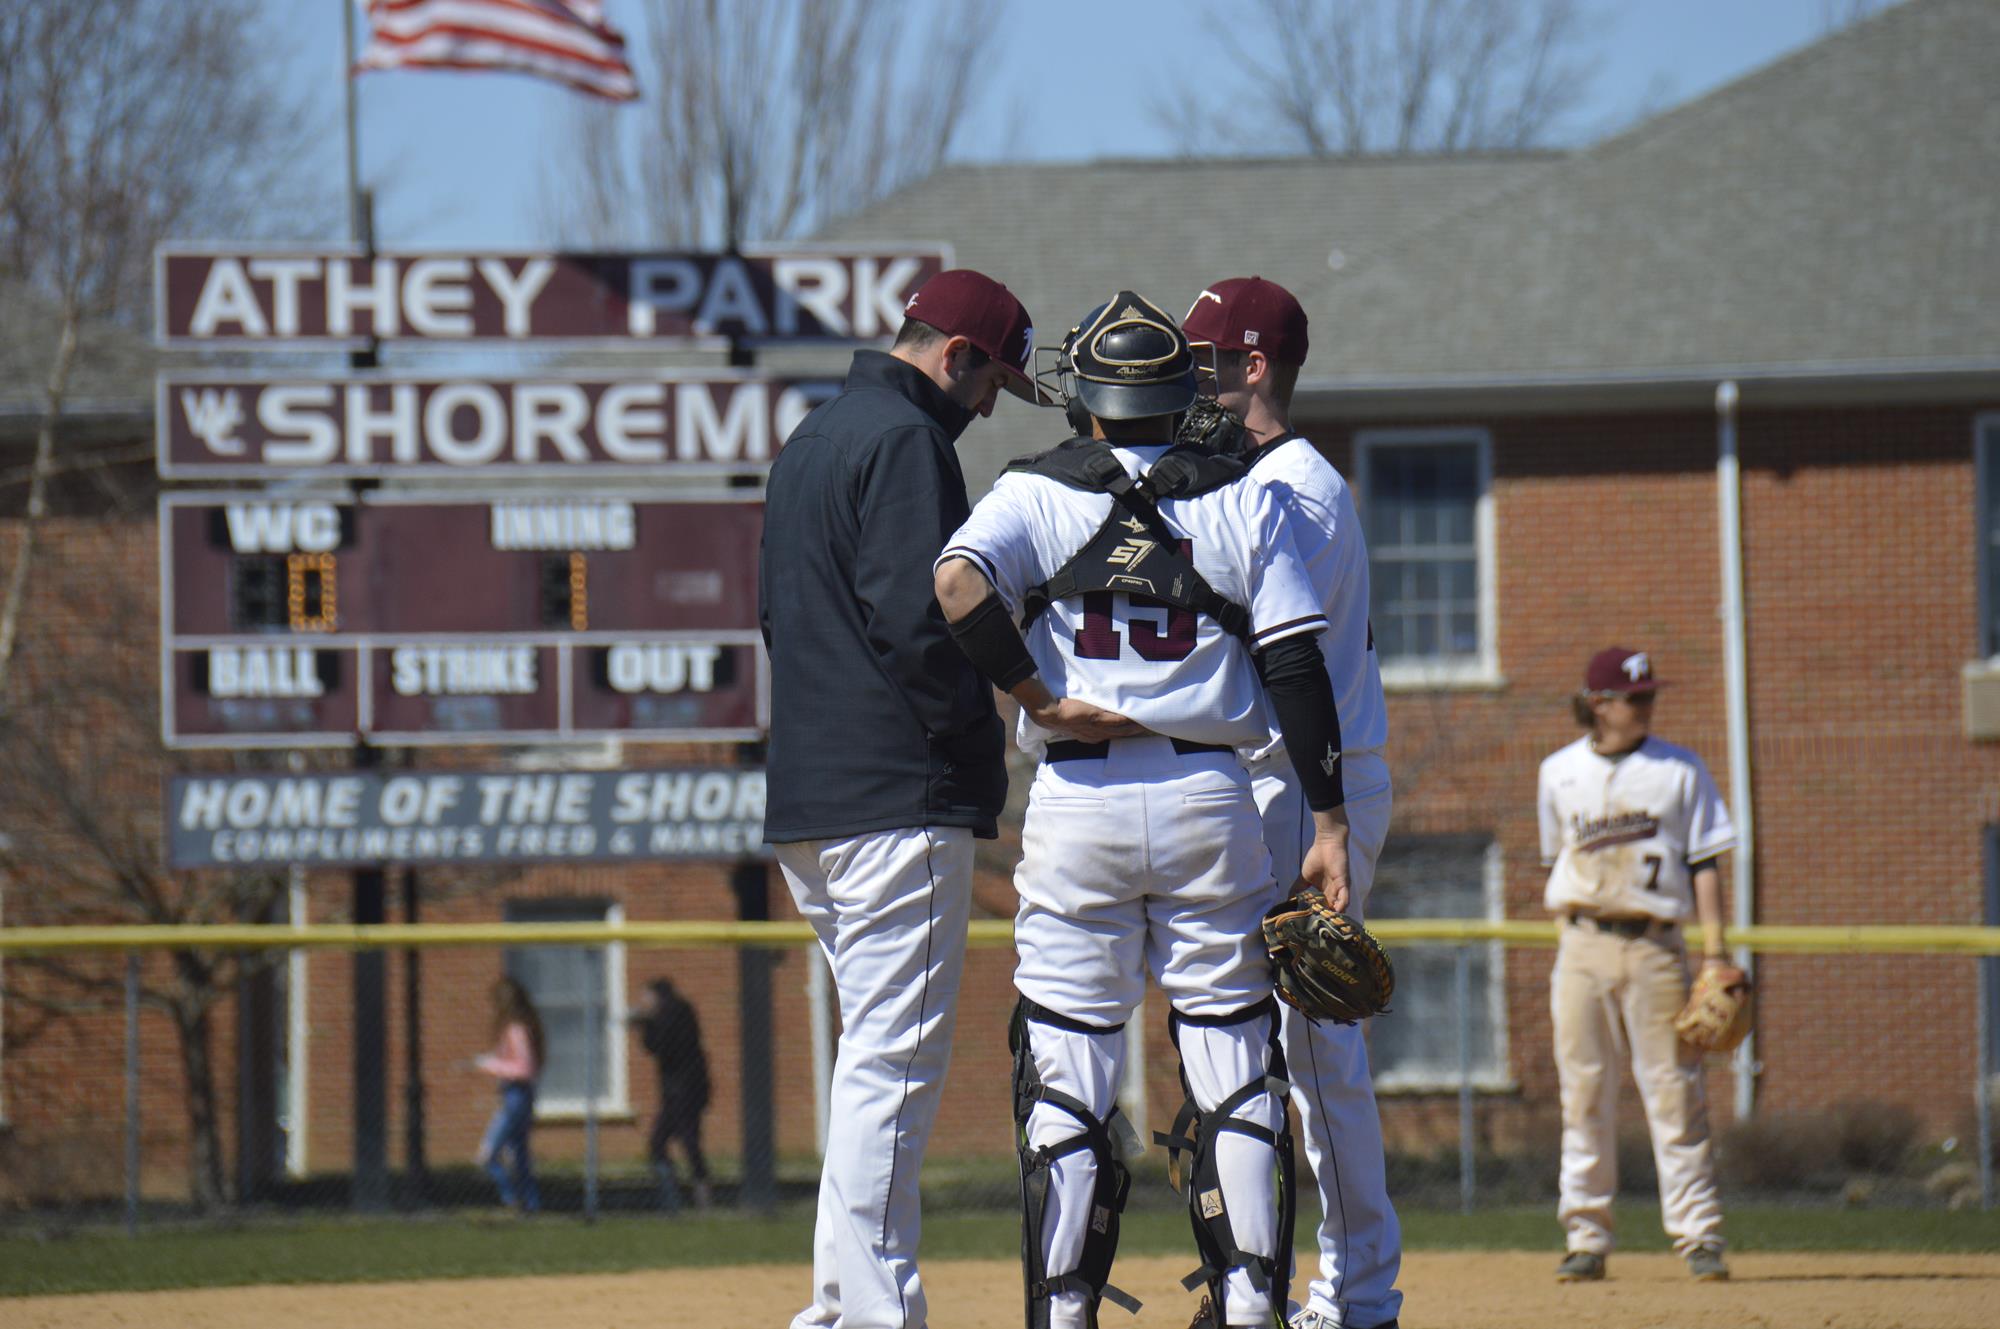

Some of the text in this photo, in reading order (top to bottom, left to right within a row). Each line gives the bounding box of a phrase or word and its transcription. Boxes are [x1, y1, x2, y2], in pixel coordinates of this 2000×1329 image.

[192, 257, 924, 338] ATHEY PARK
[225, 503, 341, 553] WC
[491, 502, 636, 551] INNING
[288, 553, 338, 632] 0
[1073, 572, 1198, 662] 15
[207, 645, 324, 698] BALL
[392, 645, 538, 695] STRIKE
[607, 646, 721, 693] OUT
[179, 777, 366, 831] HOME
[378, 777, 465, 828] OF
[477, 775, 596, 826] THE
[210, 827, 484, 863] COMPLIMENTS
[496, 825, 597, 859] FRED
[608, 827, 634, 855] &
[1644, 855, 1662, 892] 7
